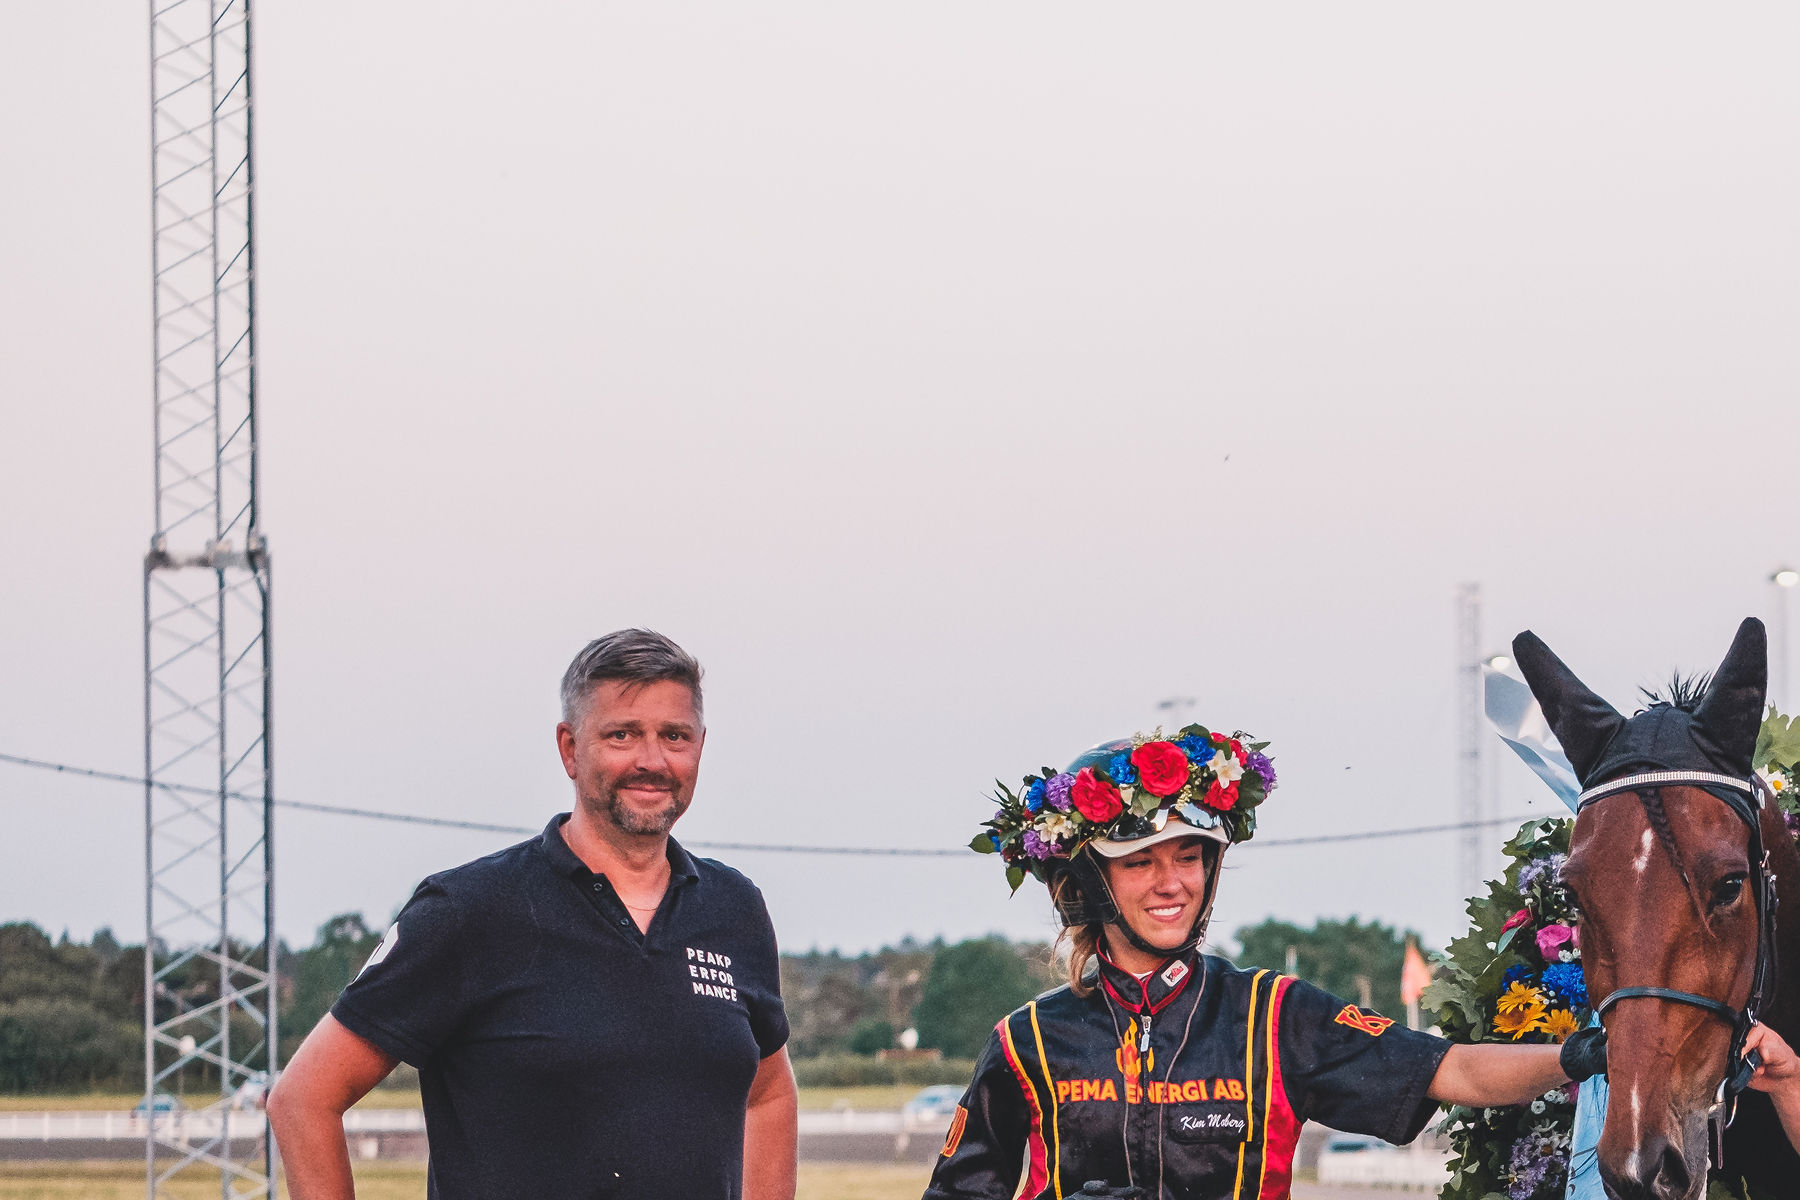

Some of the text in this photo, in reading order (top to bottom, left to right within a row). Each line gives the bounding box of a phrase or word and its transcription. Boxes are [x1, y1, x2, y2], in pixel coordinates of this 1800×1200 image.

[685, 946, 732, 968] PEAKP
[688, 964, 735, 987] ERFOR
[692, 981, 738, 1002] MANCE
[1056, 1079, 1119, 1104] PEMA
[1213, 1078, 1246, 1102] AB
[1180, 1112, 1246, 1134] Kim Moberg
